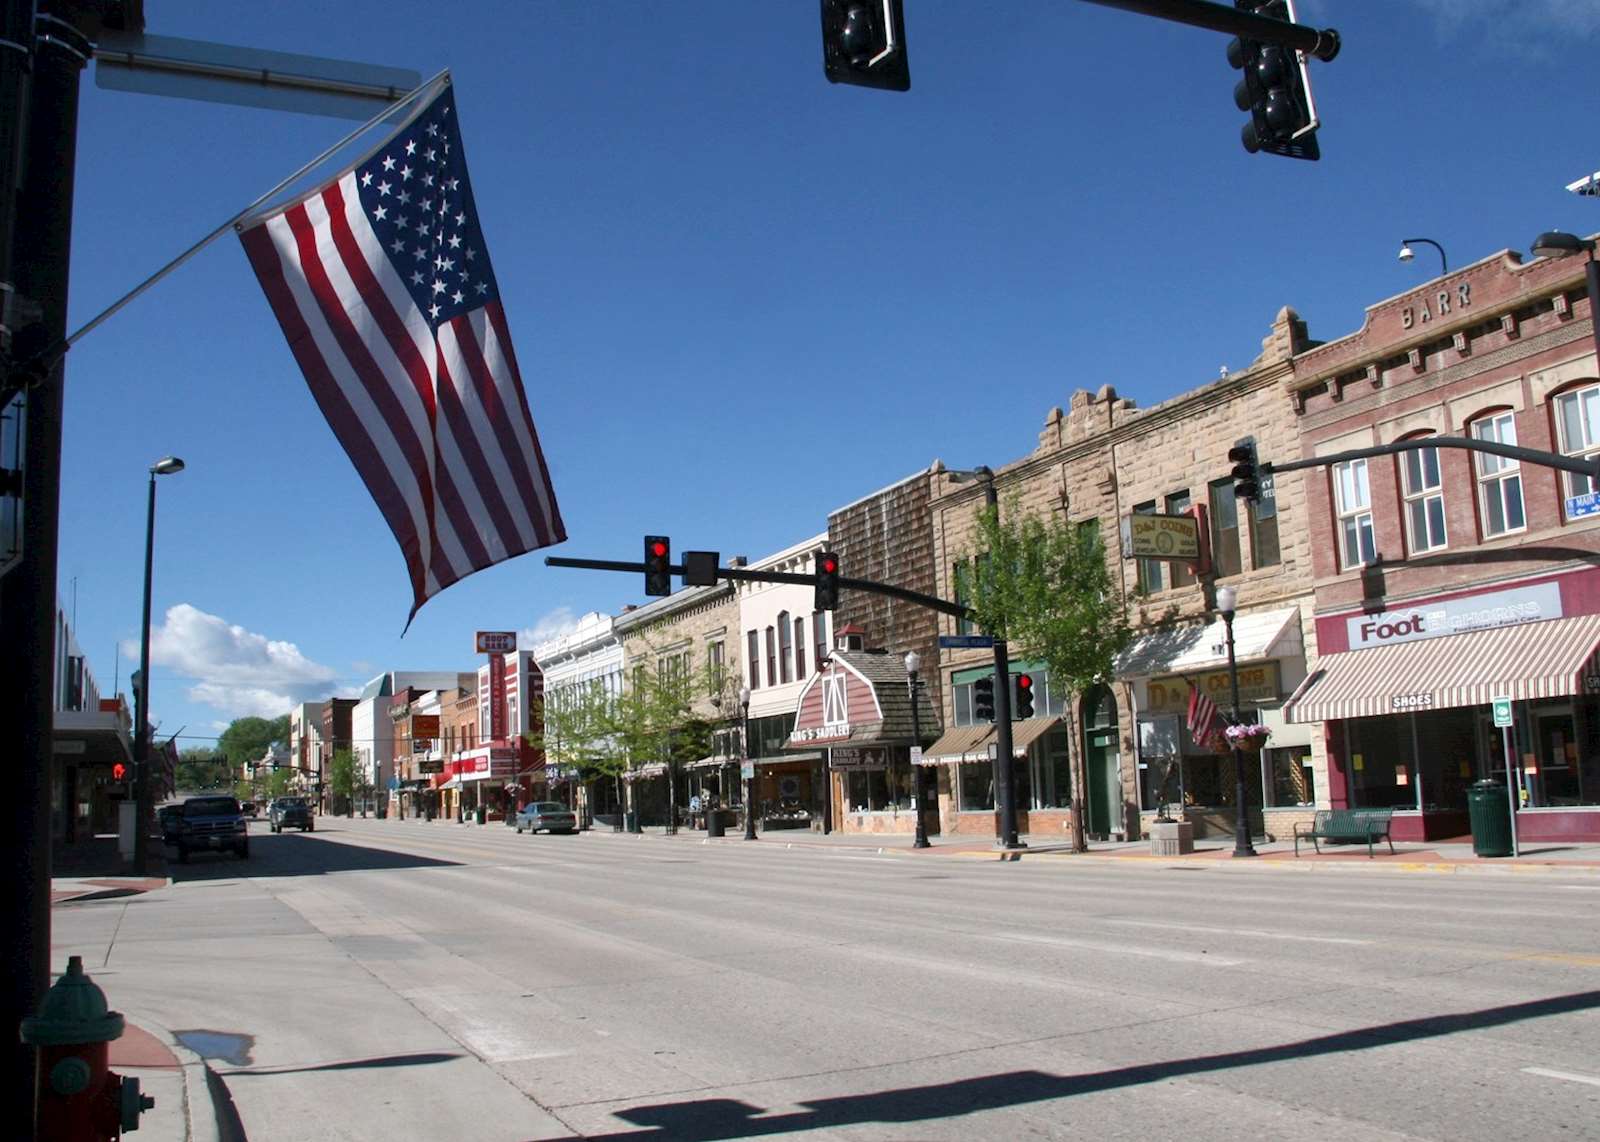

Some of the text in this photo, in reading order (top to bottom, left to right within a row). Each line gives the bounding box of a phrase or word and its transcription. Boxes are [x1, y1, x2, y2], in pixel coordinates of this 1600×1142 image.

[1402, 283, 1471, 330] BARR
[1361, 614, 1425, 642] Foot
[1393, 694, 1432, 708] SHOES
